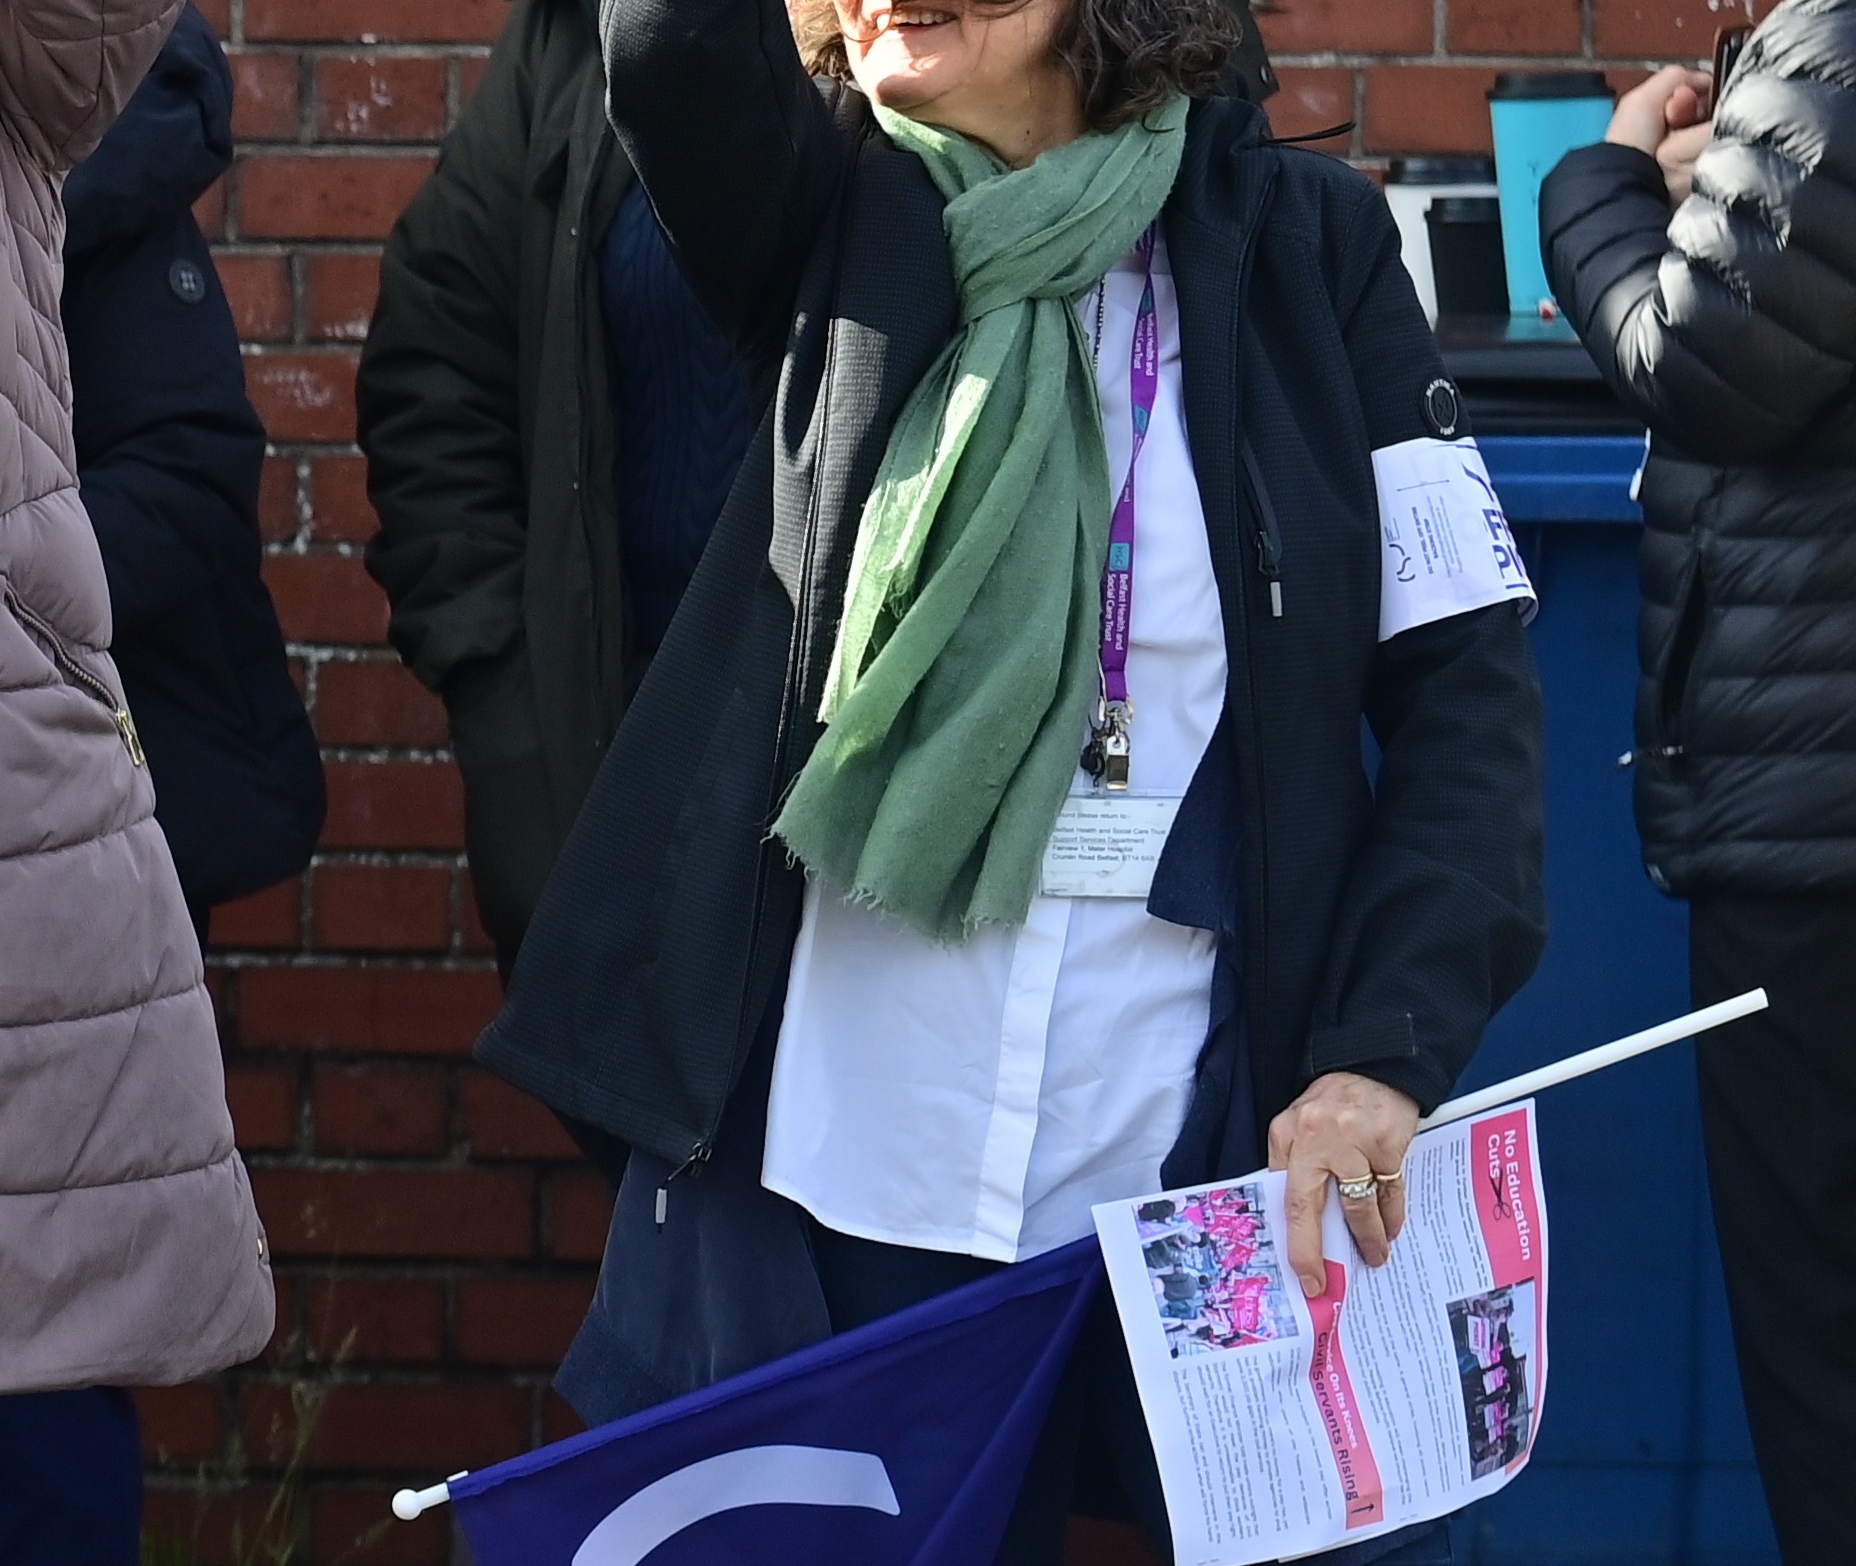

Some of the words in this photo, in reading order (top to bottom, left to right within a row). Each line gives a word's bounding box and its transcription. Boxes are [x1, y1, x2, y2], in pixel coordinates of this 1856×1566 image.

[1119, 573, 1129, 603] Belfast
[1105, 599, 1115, 620] Care
[1116, 603, 1126, 633] Health
[1115, 633, 1124, 651] and
[1488, 1133, 1501, 1179] Cuts
[1503, 1129, 1517, 1158] No
[1505, 1161, 1532, 1261] Education
[1312, 1370, 1343, 1445] Servants
[1337, 1448, 1359, 1501] Rising
